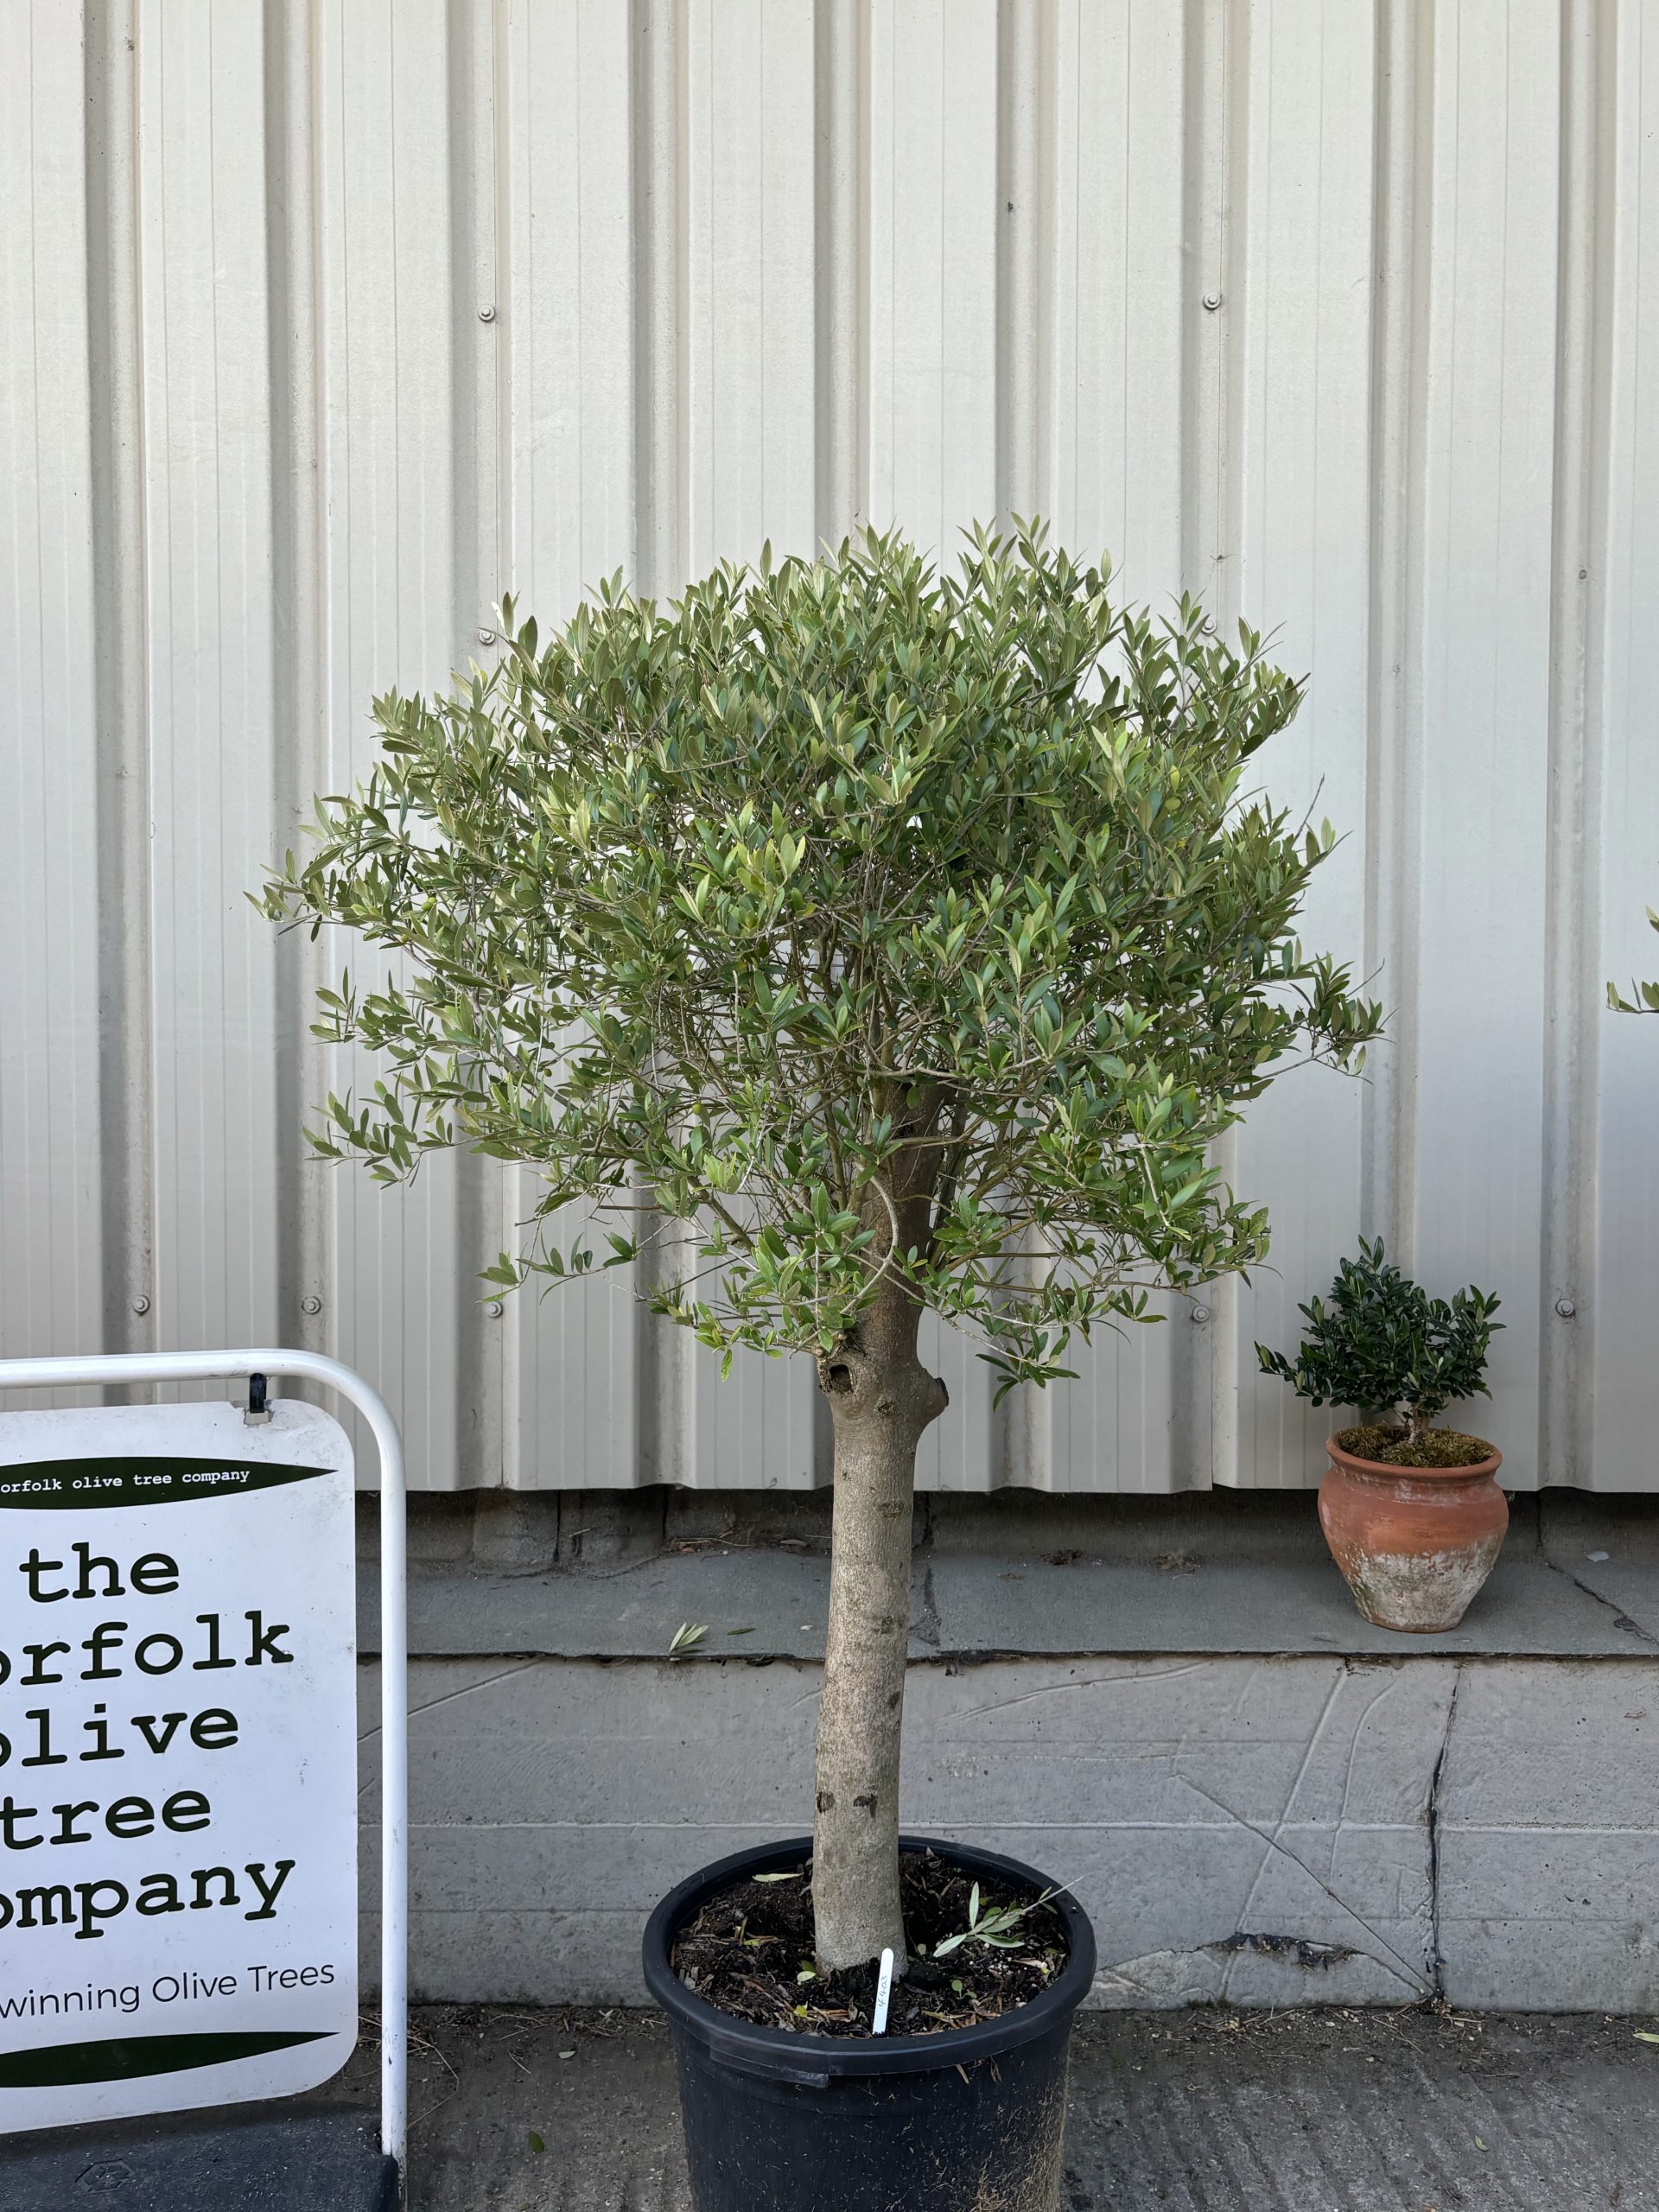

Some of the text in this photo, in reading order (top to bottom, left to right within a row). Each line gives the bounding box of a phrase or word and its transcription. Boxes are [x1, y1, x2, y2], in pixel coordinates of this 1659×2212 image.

[72, 1476, 123, 1490] olive
[133, 1474, 172, 1485] tree
[181, 1471, 251, 1484] company
[18, 1541, 180, 1604] the
[0, 1610, 295, 1686] rfolk
[0, 1703, 238, 1768] live
[0, 1789, 211, 1851] tree
[0, 1859, 296, 1940] mpany
[0, 1964, 334, 2018] winning Olive Trees
